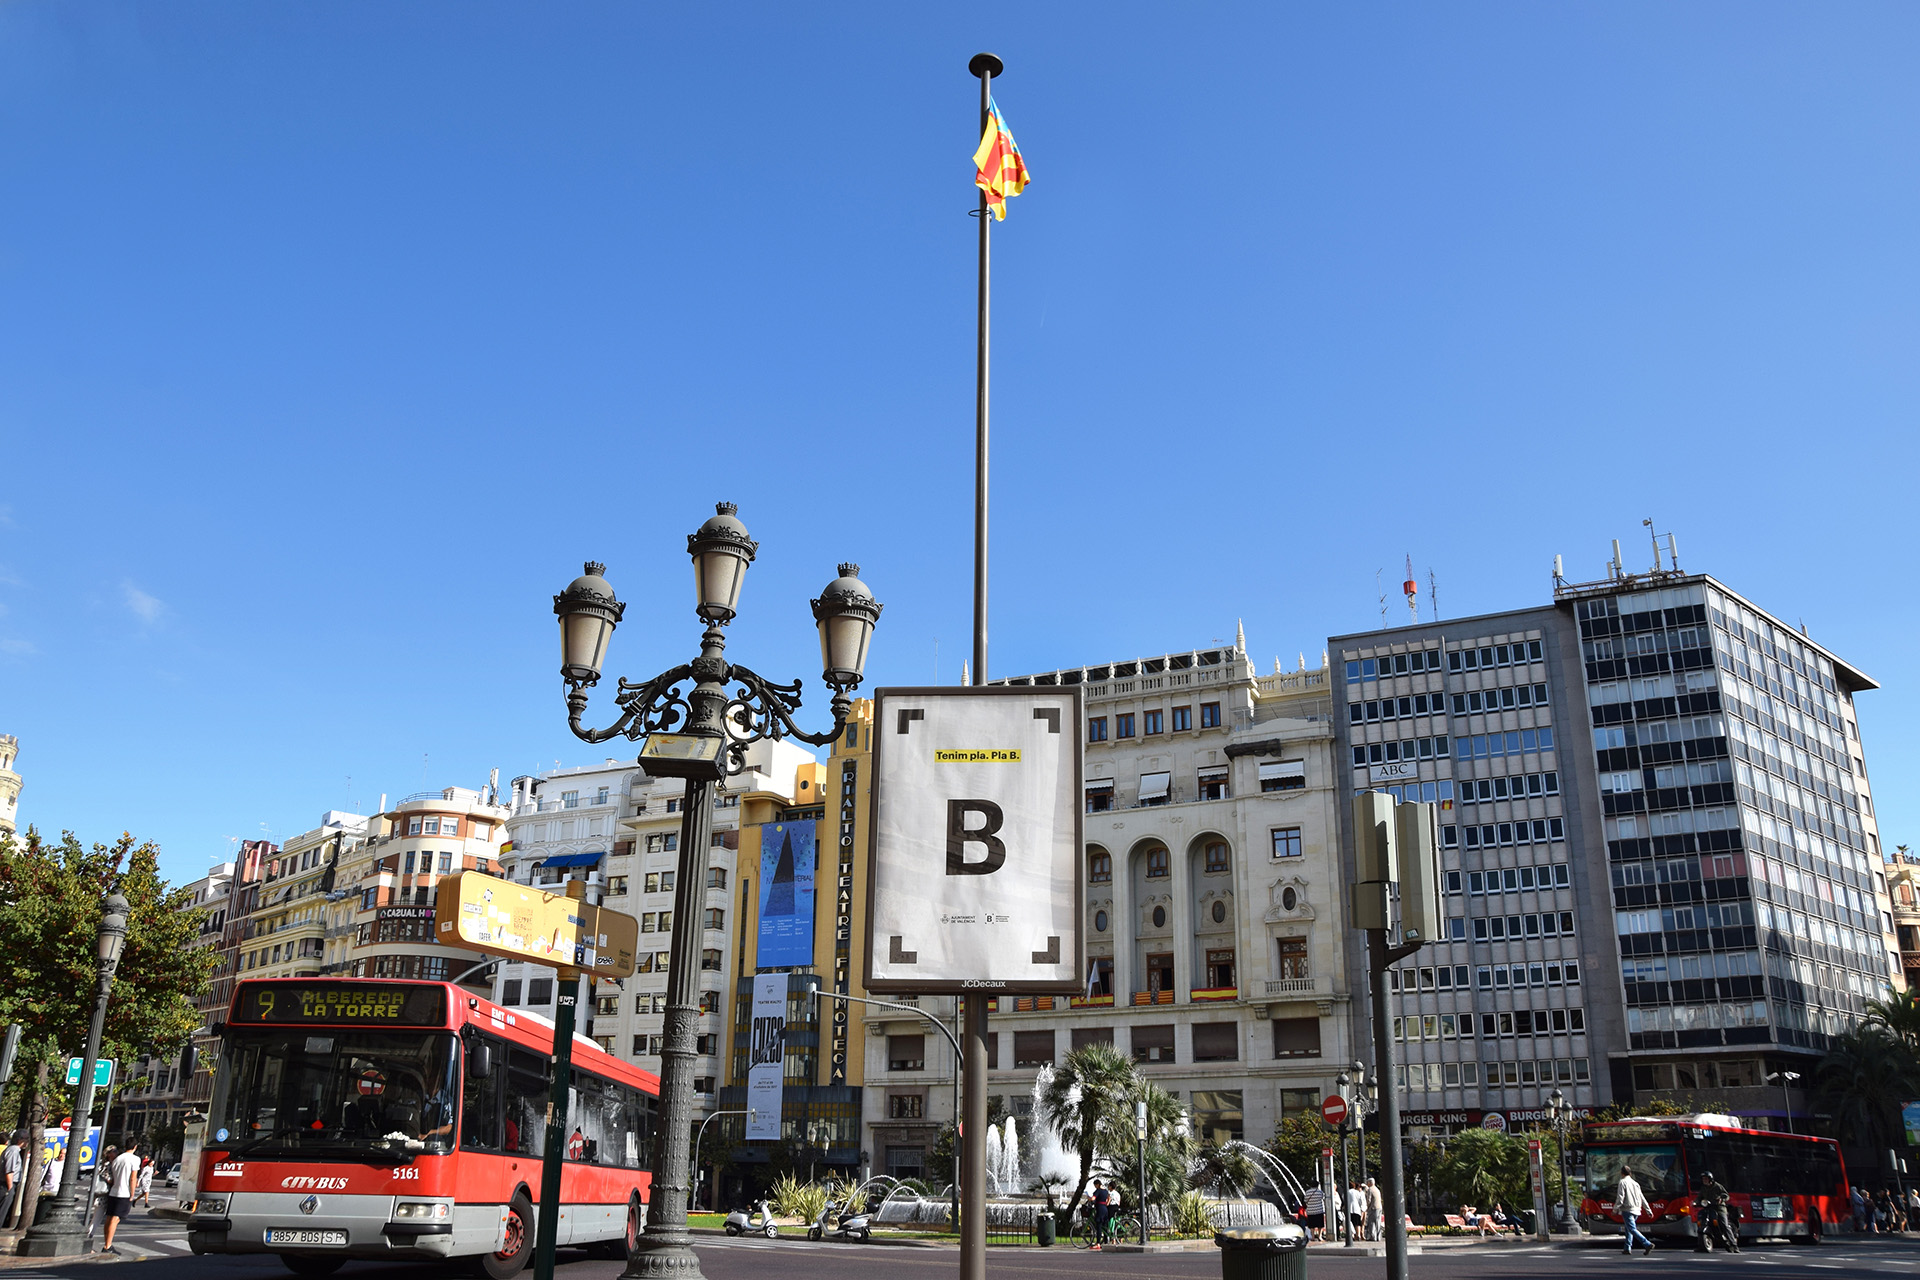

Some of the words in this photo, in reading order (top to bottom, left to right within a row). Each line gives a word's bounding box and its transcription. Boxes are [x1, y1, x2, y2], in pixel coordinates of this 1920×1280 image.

[937, 751, 967, 760] Tenim
[970, 751, 989, 761] pla.
[991, 751, 1007, 760] Pla
[1010, 751, 1020, 760] B.
[1379, 763, 1408, 776] ABC
[841, 772, 855, 847] RIALTO
[946, 799, 1006, 875] B
[837, 863, 852, 939] TEATRE
[387, 908, 417, 918] CASUAL
[418, 908, 436, 918] HOT
[961, 980, 1006, 988] JCDecaux
[258, 990, 275, 1020] 9
[302, 990, 405, 1005] ALBEREDA
[303, 1004, 327, 1017] LA
[335, 1004, 399, 1018] TORRE
[491, 1008, 505, 1021] EMT
[833, 957, 848, 1079] FILMOTECA
[752, 1016, 784, 1064] CUZCO
[1400, 1114, 1435, 1125] URGER
[1440, 1113, 1467, 1123] KING
[1510, 1110, 1547, 1122] BURGE
[214, 1163, 244, 1171] EMT
[392, 1167, 419, 1180] 5161
[281, 1176, 349, 1189] CITYBUS
[273, 1231, 296, 1242] 9857
[301, 1231, 320, 1242] BDS
